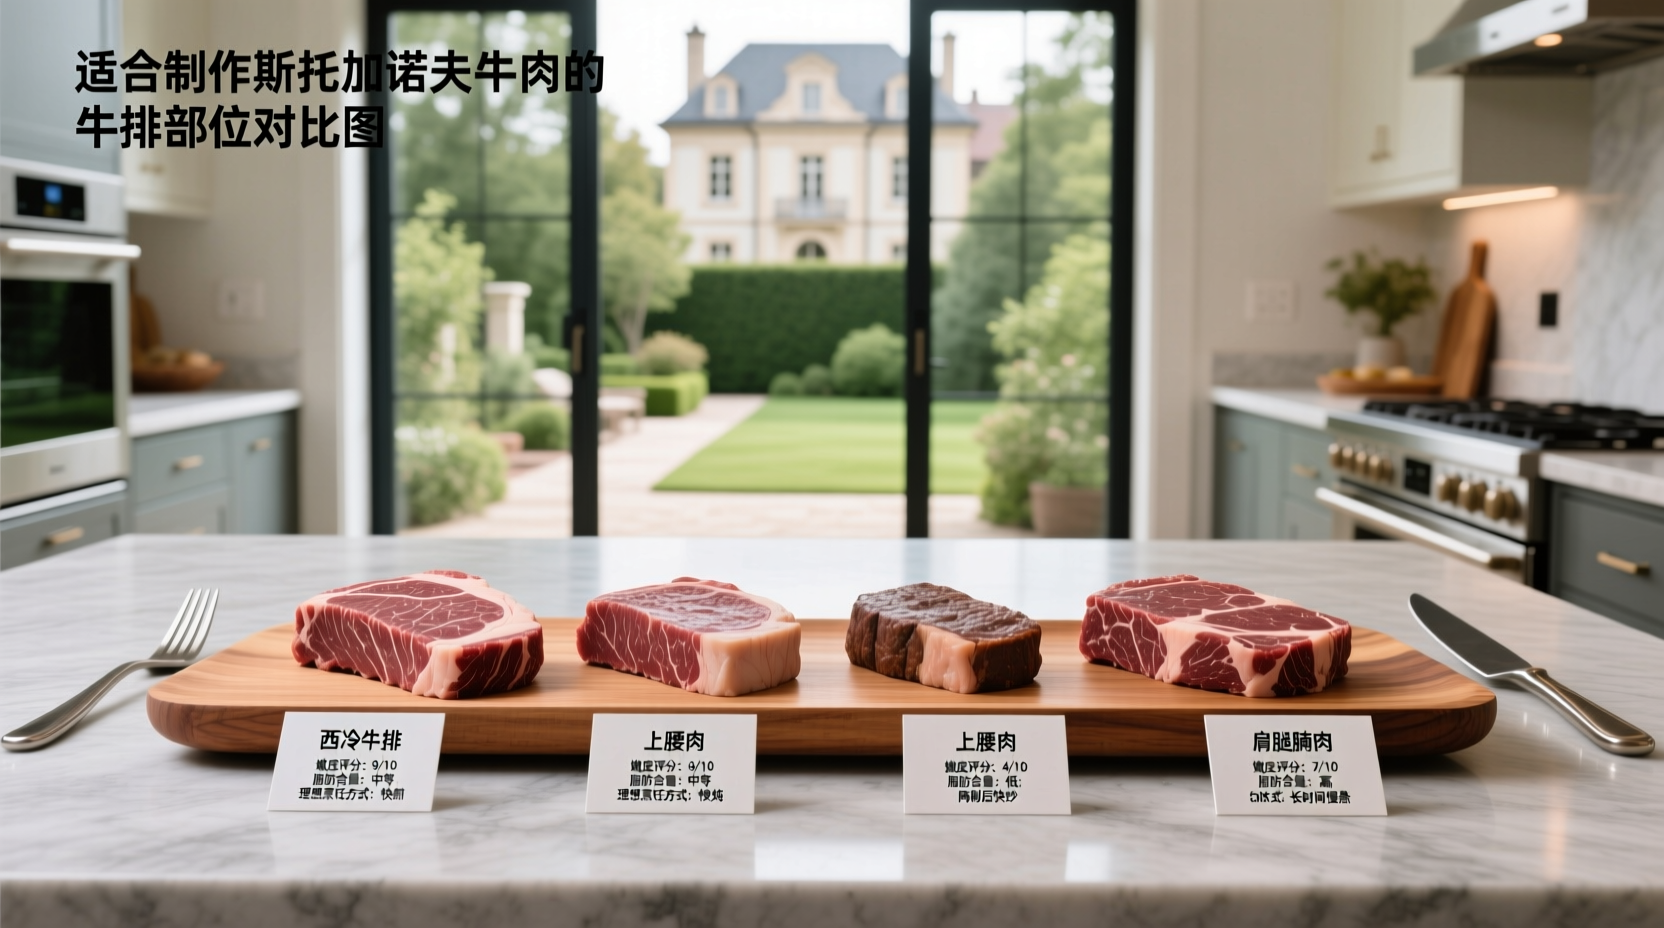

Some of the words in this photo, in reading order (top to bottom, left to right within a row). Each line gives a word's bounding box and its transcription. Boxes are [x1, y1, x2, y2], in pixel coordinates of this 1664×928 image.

[320, 729, 403, 751] 西冷牛排
[644, 729, 705, 752] 上腰肉
[956, 730, 1016, 753] 上腰肉
